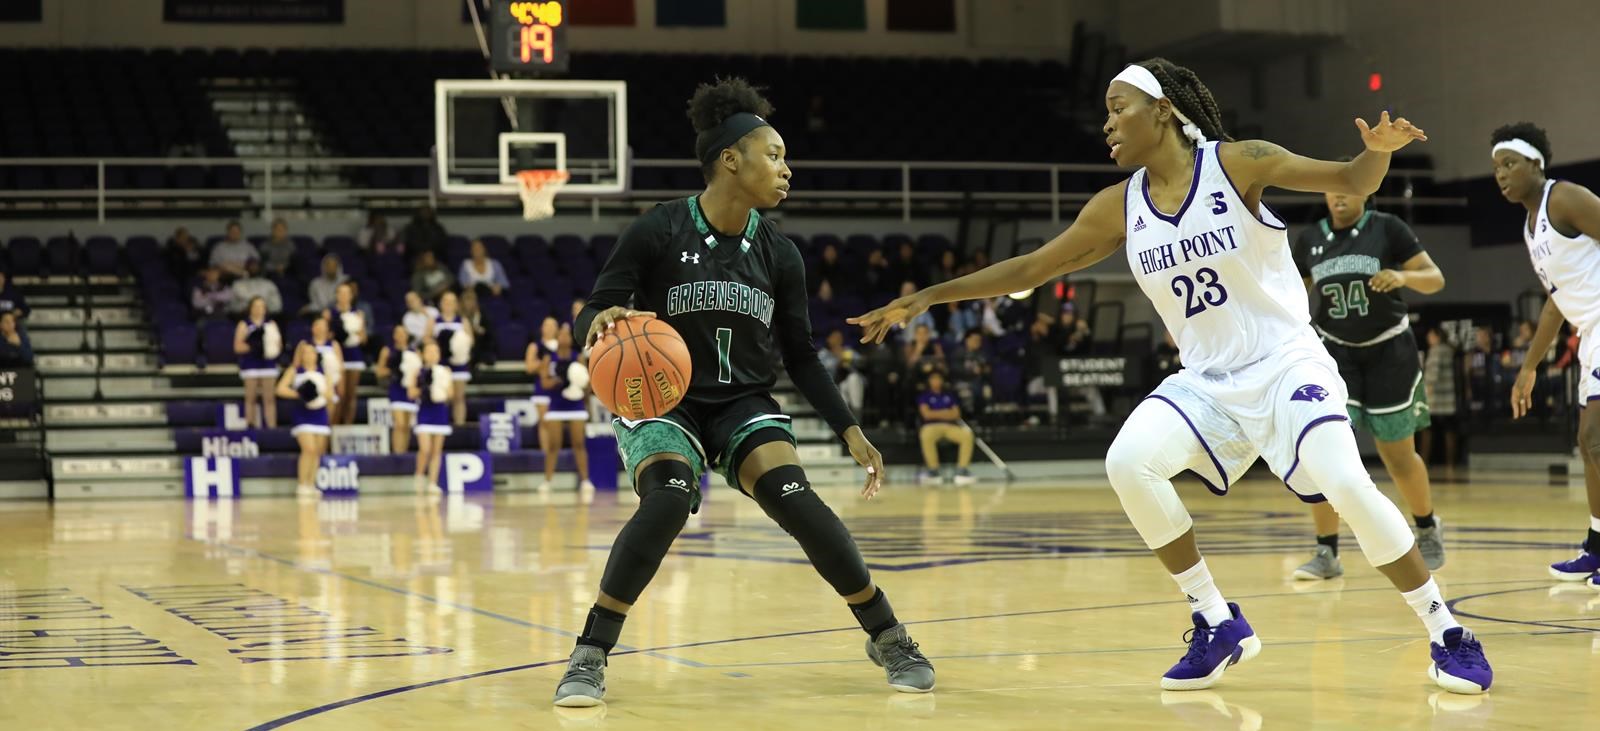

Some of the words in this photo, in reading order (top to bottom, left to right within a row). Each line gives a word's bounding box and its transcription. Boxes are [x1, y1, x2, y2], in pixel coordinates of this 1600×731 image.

[521, 24, 553, 63] 19
[1138, 243, 1178, 275] HIGH
[1178, 225, 1238, 262] POINT
[667, 280, 775, 329] GREENSBORO
[1171, 267, 1228, 319] 23
[1322, 280, 1370, 319] 34
[715, 327, 732, 384] 1
[1059, 358, 1126, 373] STUDENT
[1063, 373, 1124, 387] SEATING
[191, 456, 234, 497] H
[316, 459, 359, 490] oint
[445, 452, 485, 491] P
